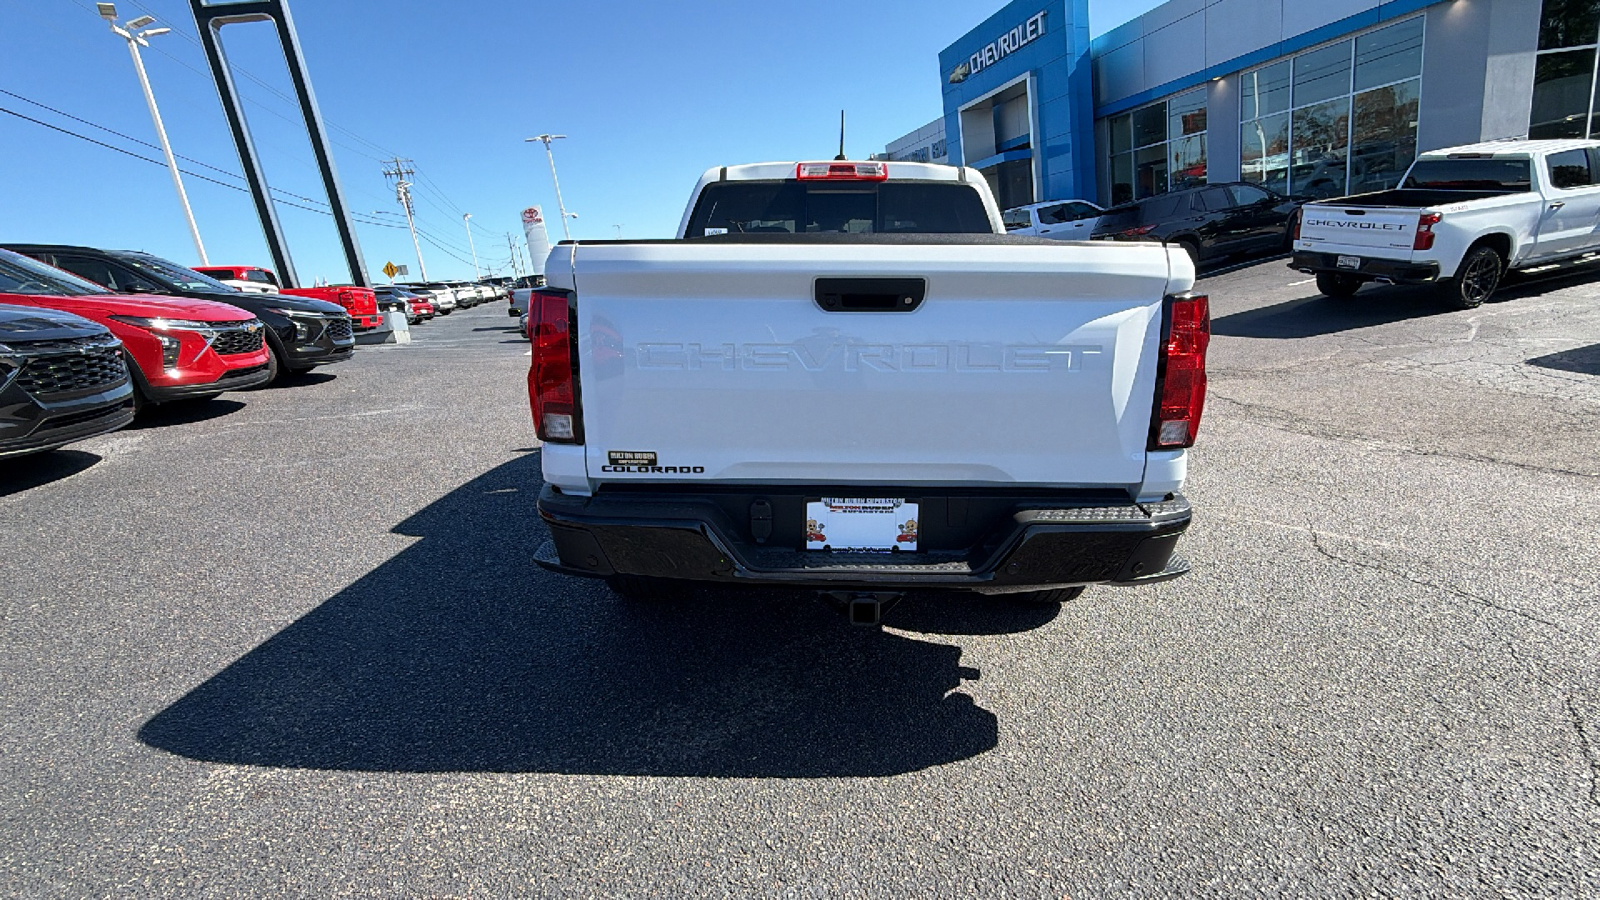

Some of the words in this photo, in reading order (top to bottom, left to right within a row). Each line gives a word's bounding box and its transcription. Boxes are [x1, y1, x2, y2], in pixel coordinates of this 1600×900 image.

[969, 10, 1047, 74] CHEVROLET
[1307, 219, 1407, 231] CHEVROLET
[636, 342, 1103, 373] CHEVROLET
[602, 466, 704, 474] COLORADO
